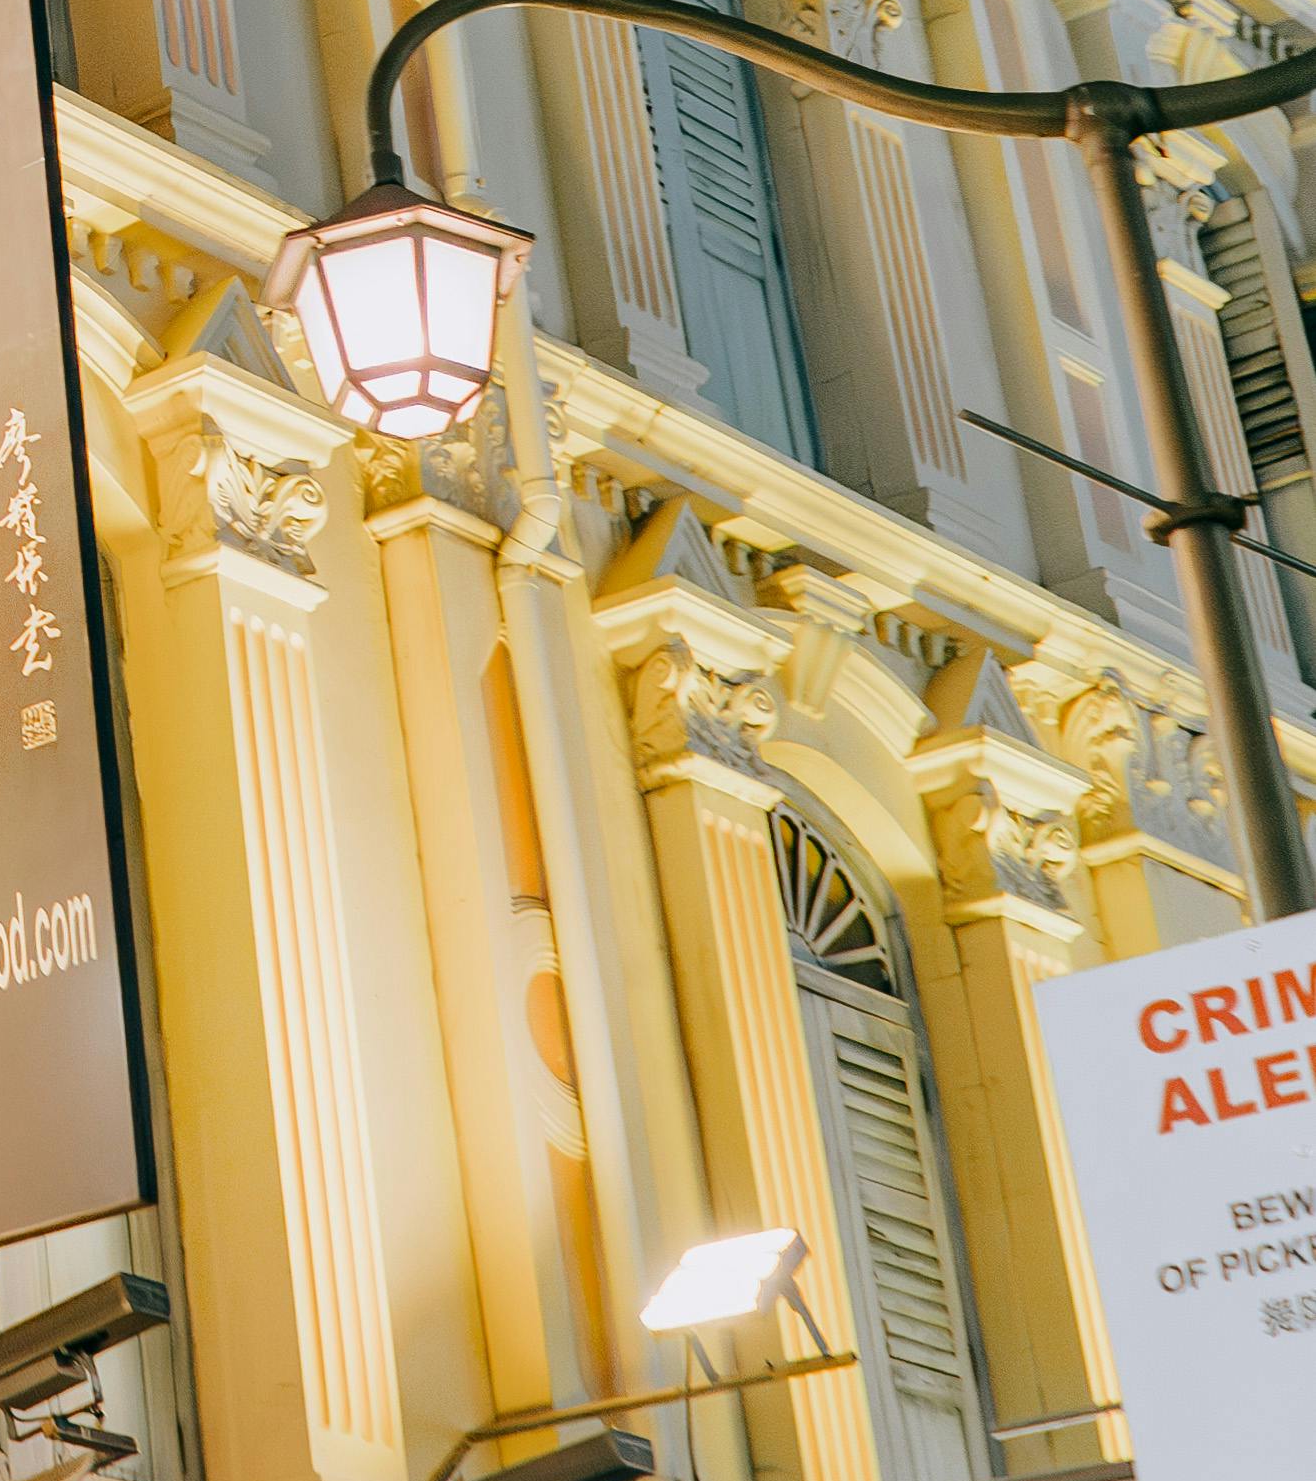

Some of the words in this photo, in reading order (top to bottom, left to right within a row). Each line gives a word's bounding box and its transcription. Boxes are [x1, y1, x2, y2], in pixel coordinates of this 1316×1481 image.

[1158, 1044, 1316, 1136] ALE
[1158, 1257, 1209, 1294] OF
[1218, 1233, 1316, 1282] PICK
